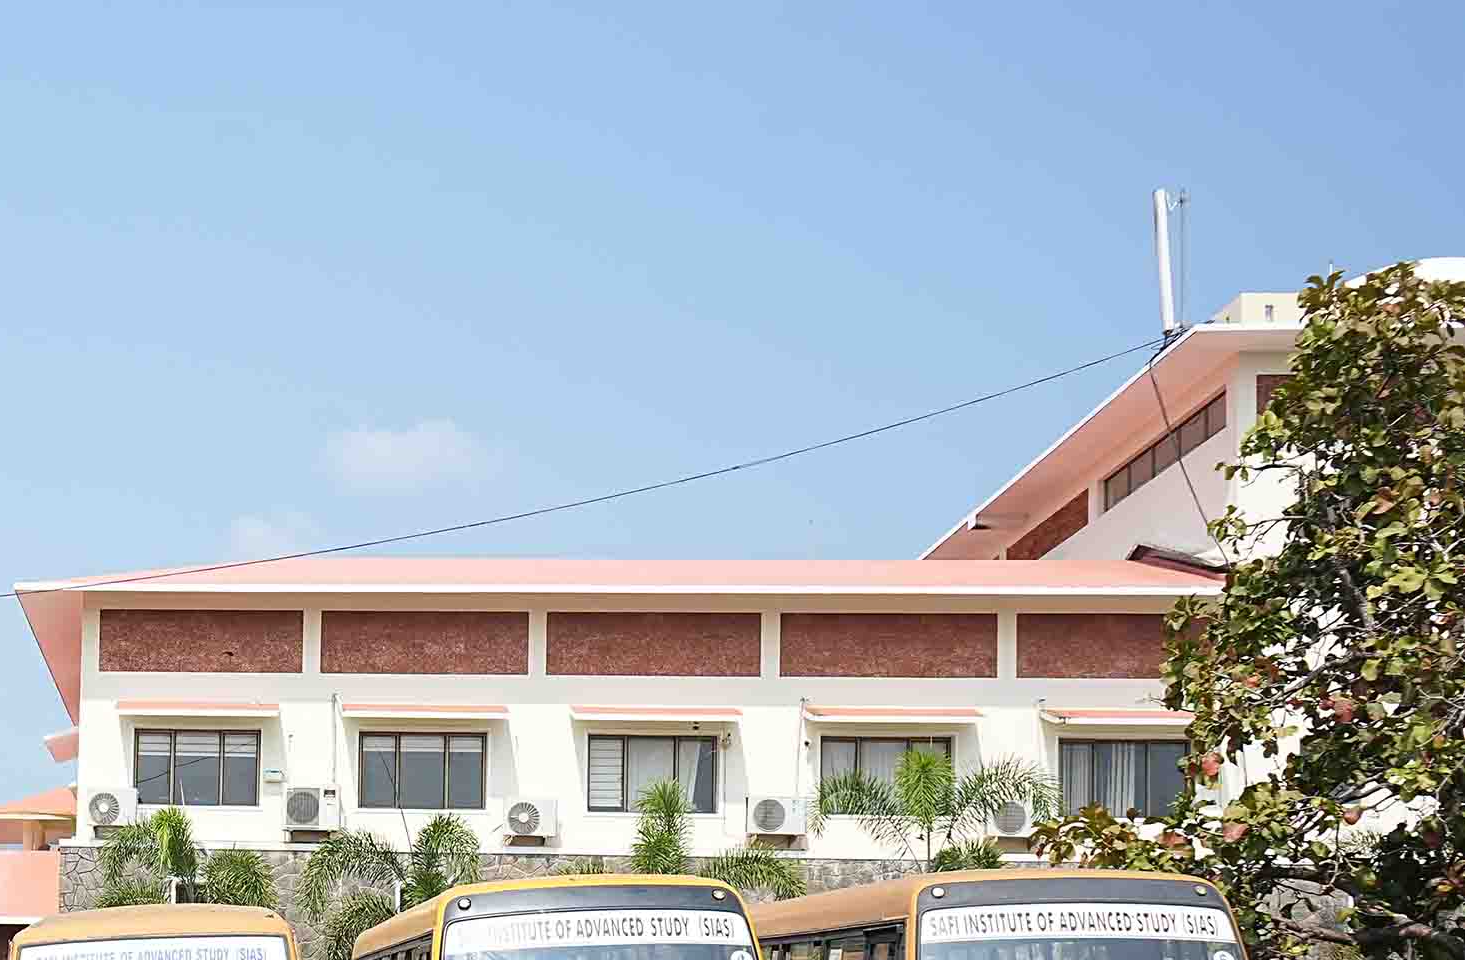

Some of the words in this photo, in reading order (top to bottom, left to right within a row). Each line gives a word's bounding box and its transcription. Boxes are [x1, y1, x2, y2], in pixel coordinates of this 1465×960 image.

[555, 919, 571, 938] OF
[576, 917, 644, 937] ADVANCED
[651, 917, 689, 937] STUDY
[699, 917, 735, 939] (SIAS)
[930, 915, 960, 936] SAFI
[963, 912, 1032, 934] INSTITUTE
[1037, 912, 1054, 932] OF
[1060, 911, 1132, 931] ADVANCED
[1137, 912, 1176, 931] STUDY
[1183, 913, 1219, 936] (SIAS)
